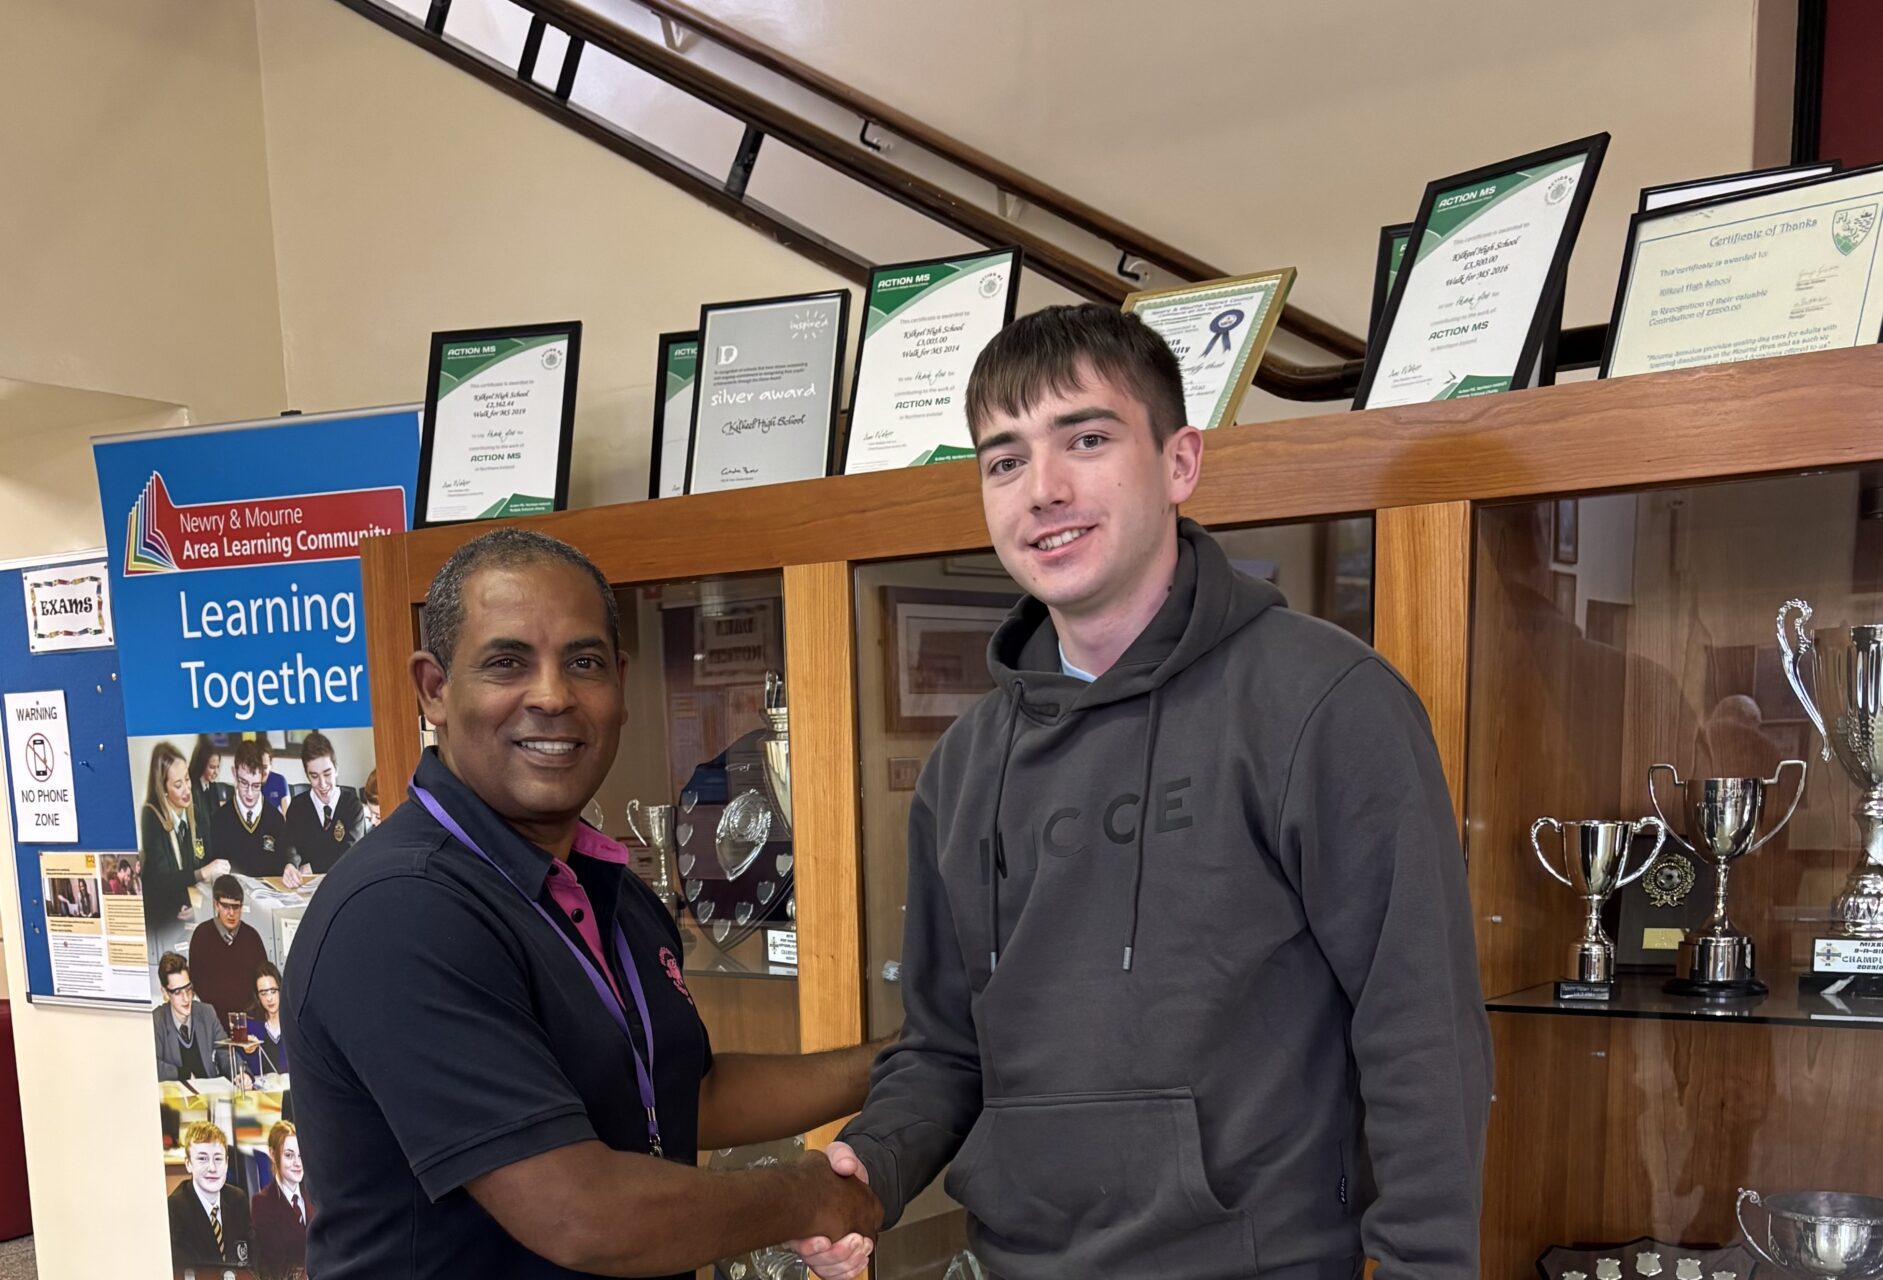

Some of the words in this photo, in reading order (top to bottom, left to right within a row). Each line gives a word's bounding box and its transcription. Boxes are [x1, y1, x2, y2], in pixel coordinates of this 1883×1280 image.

[1439, 192, 1477, 208] ACTION
[1479, 186, 1496, 197] MS
[1710, 230, 1762, 248] Certificate
[1765, 225, 1777, 237] of
[1780, 218, 1818, 233] Thanks
[1476, 244, 1495, 256] High
[1495, 236, 1522, 250] School
[1660, 269, 1675, 278] This
[1676, 261, 1714, 275] certificate
[1724, 253, 1757, 266] awarded
[878, 277, 913, 288] ACTION
[916, 274, 931, 283] MS
[1446, 274, 1467, 286] Walk
[1476, 268, 1490, 280] MS
[1686, 282, 1704, 294] High
[1705, 276, 1732, 288] School
[1651, 309, 1658, 317] In
[1660, 300, 1705, 315] Recognition
[1706, 297, 1715, 308] of
[1716, 294, 1734, 305] their
[1735, 288, 1769, 301] valuable
[790, 318, 828, 331] inspired
[1649, 313, 1695, 327] Contribution
[1696, 310, 1706, 321] of
[904, 327, 925, 339] Kilkeel
[926, 326, 942, 337] High
[943, 323, 965, 333] School
[1428, 326, 1470, 340] ACTION
[1472, 321, 1490, 332] MS
[448, 347, 480, 356] ACTION
[902, 349, 921, 359] Walk
[918, 348, 930, 359] for
[930, 346, 943, 355] MS
[495, 392, 509, 401] High
[510, 390, 530, 398] School
[710, 388, 754, 406] silver
[759, 383, 816, 400] award
[895, 399, 932, 410] ACTION
[935, 397, 951, 405] MS
[474, 411, 491, 419] Walk
[489, 410, 500, 419] for
[500, 409, 510, 417] MS
[758, 416, 777, 434] High
[778, 414, 806, 426] School
[470, 454, 504, 463] ACTION
[507, 452, 522, 460] MS
[180, 512, 225, 535] Newry
[230, 508, 241, 530] &
[245, 507, 303, 527] Mourne
[183, 540, 219, 560] Area
[224, 533, 292, 557] Learning
[180, 582, 356, 644] Learning
[181, 653, 364, 720] Together
[16, 707, 58, 722] WARNING
[22, 790, 36, 803] NO
[38, 789, 69, 803] PHONE
[35, 814, 60, 827] ZONE
